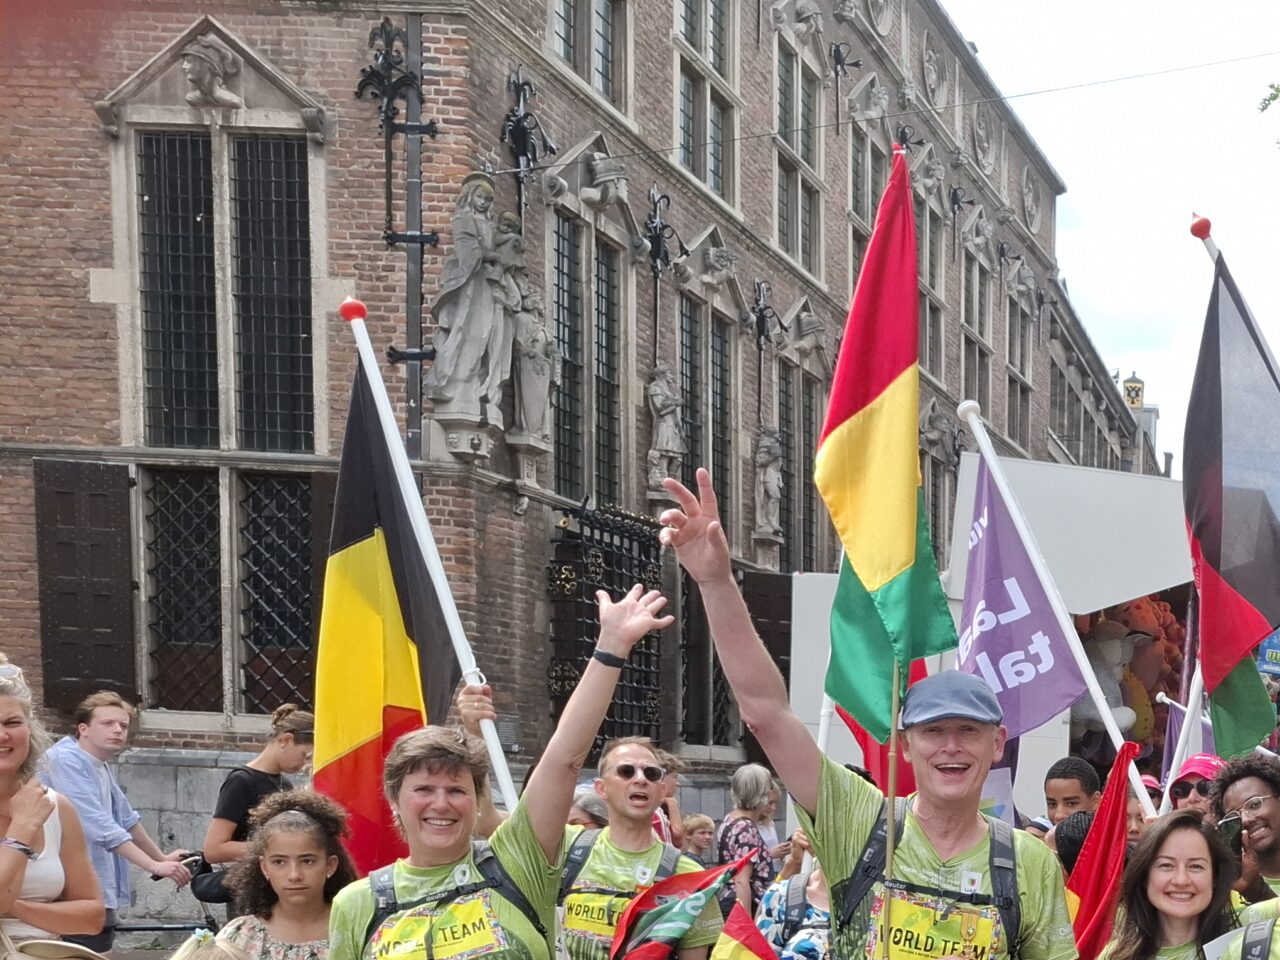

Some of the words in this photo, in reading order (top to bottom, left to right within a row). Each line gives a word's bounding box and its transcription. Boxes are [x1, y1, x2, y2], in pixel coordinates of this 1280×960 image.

[883, 880, 907, 890] deuter
[425, 892, 448, 902] deuter
[567, 902, 605, 921] WORLD
[439, 917, 487, 943] TEAM
